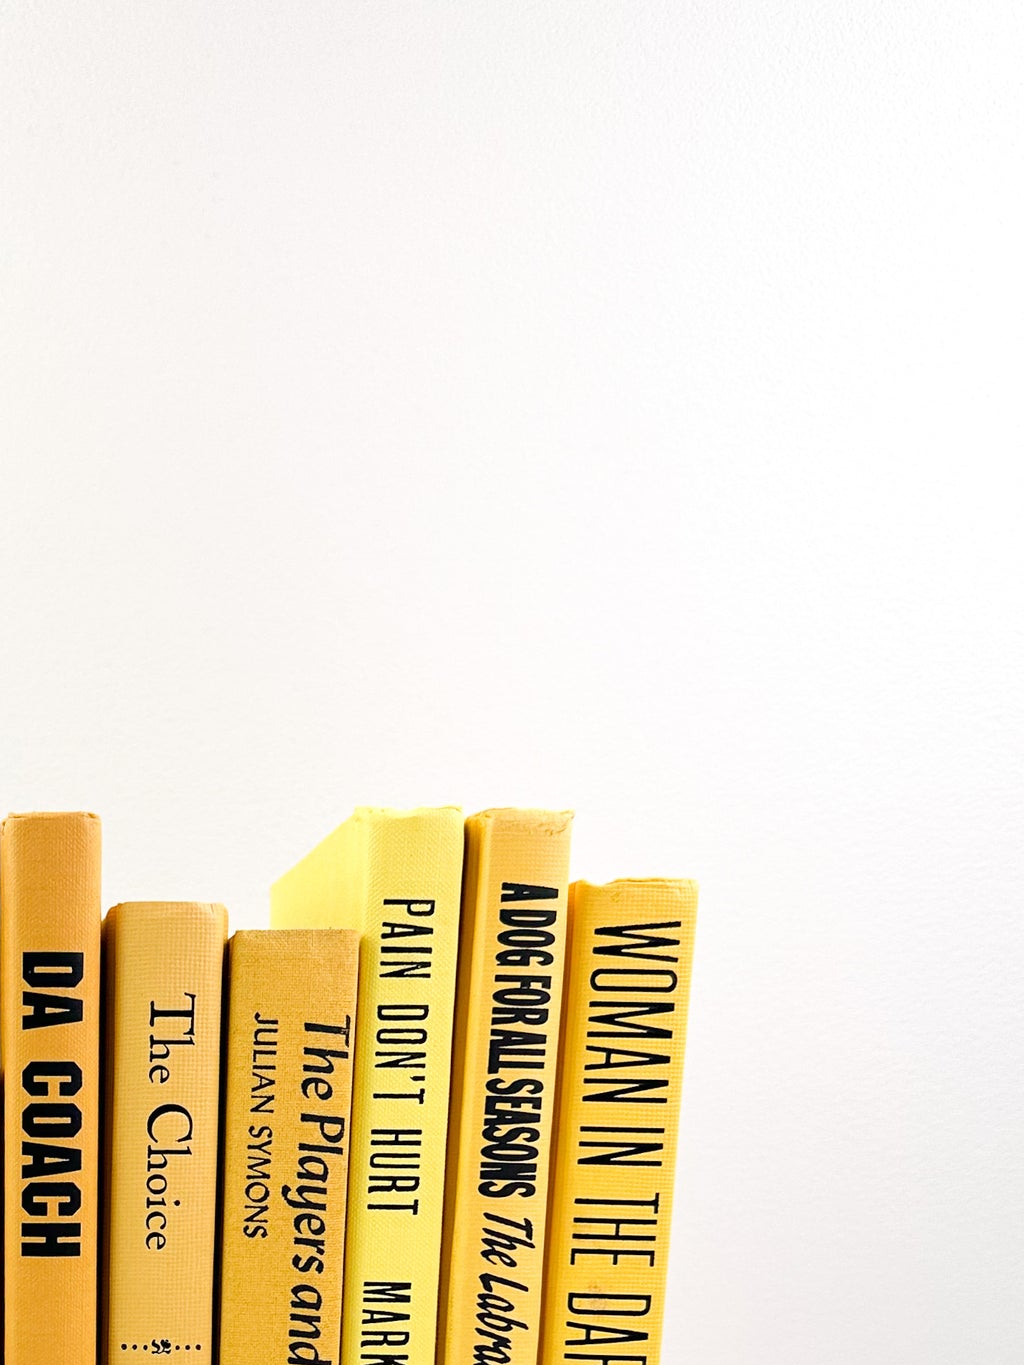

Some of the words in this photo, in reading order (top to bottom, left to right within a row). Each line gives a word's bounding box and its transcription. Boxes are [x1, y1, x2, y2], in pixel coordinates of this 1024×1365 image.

[500, 881, 559, 903] A
[378, 898, 436, 979] PAIN
[495, 908, 558, 967] DOG
[21, 951, 85, 1031] DA
[490, 974, 553, 1026] FOR
[581, 920, 682, 1104] WOMAN
[148, 992, 197, 1084] The
[249, 1011, 279, 1114] JULIAN
[299, 1014, 351, 1101] The
[372, 1004, 430, 1105] DON'T
[487, 1028, 548, 1075] ALL
[20, 1060, 83, 1258] COACH
[145, 1103, 193, 1251] Choice
[366, 1128, 423, 1216] HURT
[477, 1077, 544, 1199] SEASONS
[576, 1125, 666, 1167] IN
[242, 1125, 273, 1239] SYMONS
[280, 1112, 344, 1276] Players
[480, 1212, 536, 1268] The
[569, 1192, 660, 1268] THE
